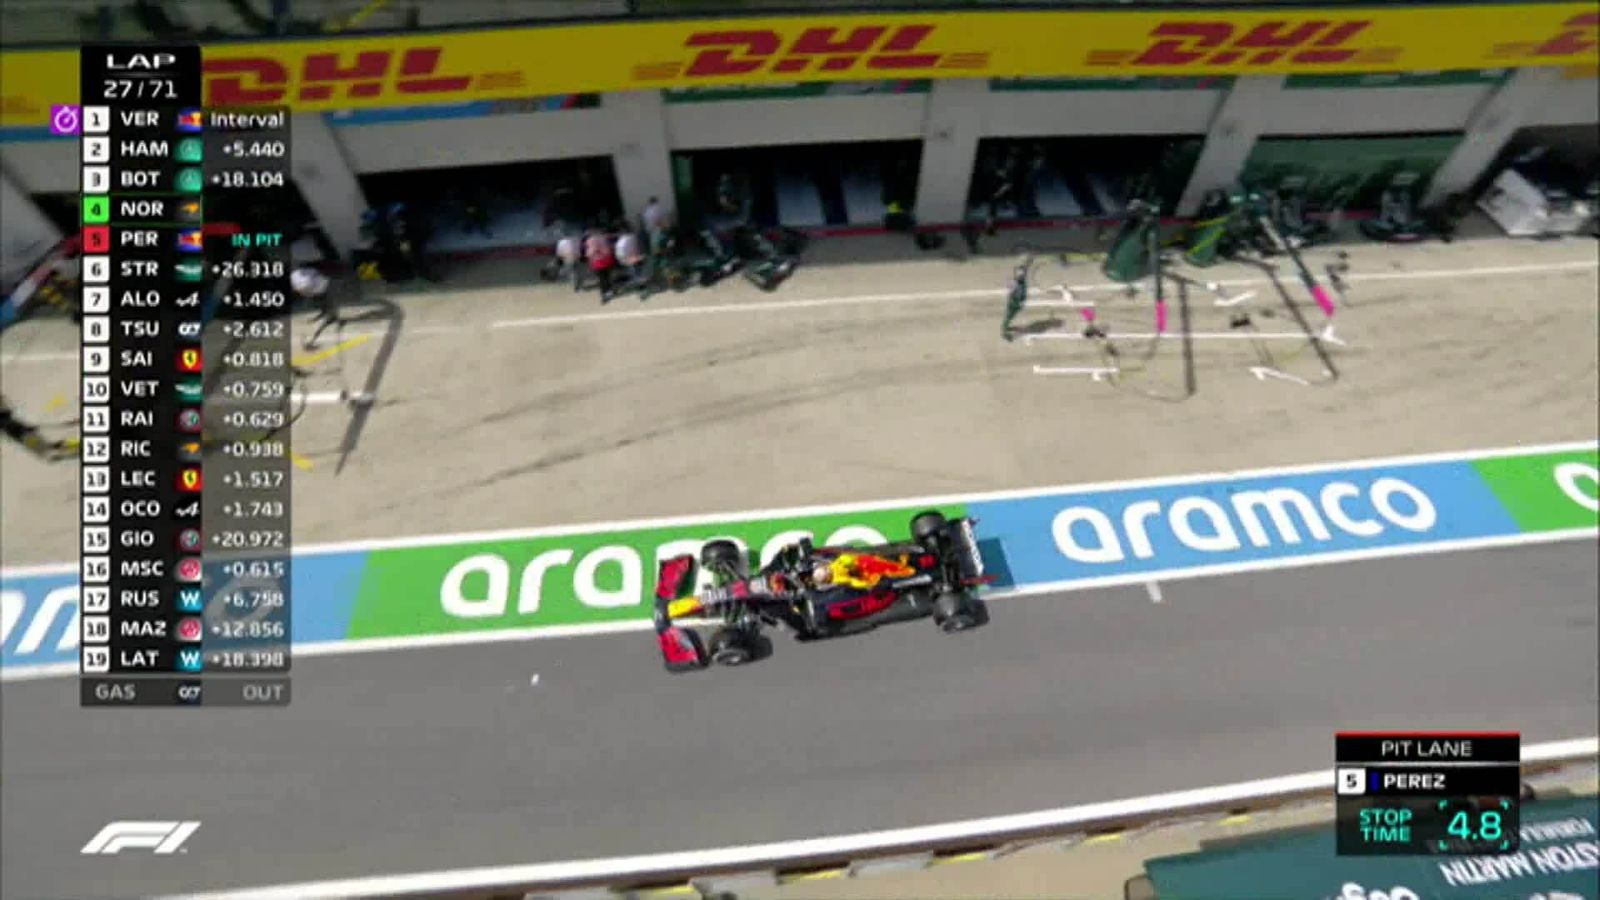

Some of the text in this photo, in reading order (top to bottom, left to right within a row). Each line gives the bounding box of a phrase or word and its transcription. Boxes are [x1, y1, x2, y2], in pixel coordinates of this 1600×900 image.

[684, 24, 942, 77] DHL
[1132, 20, 1374, 65] DHL
[202, 48, 473, 106] DHL
[1051, 477, 1437, 563] aramco
